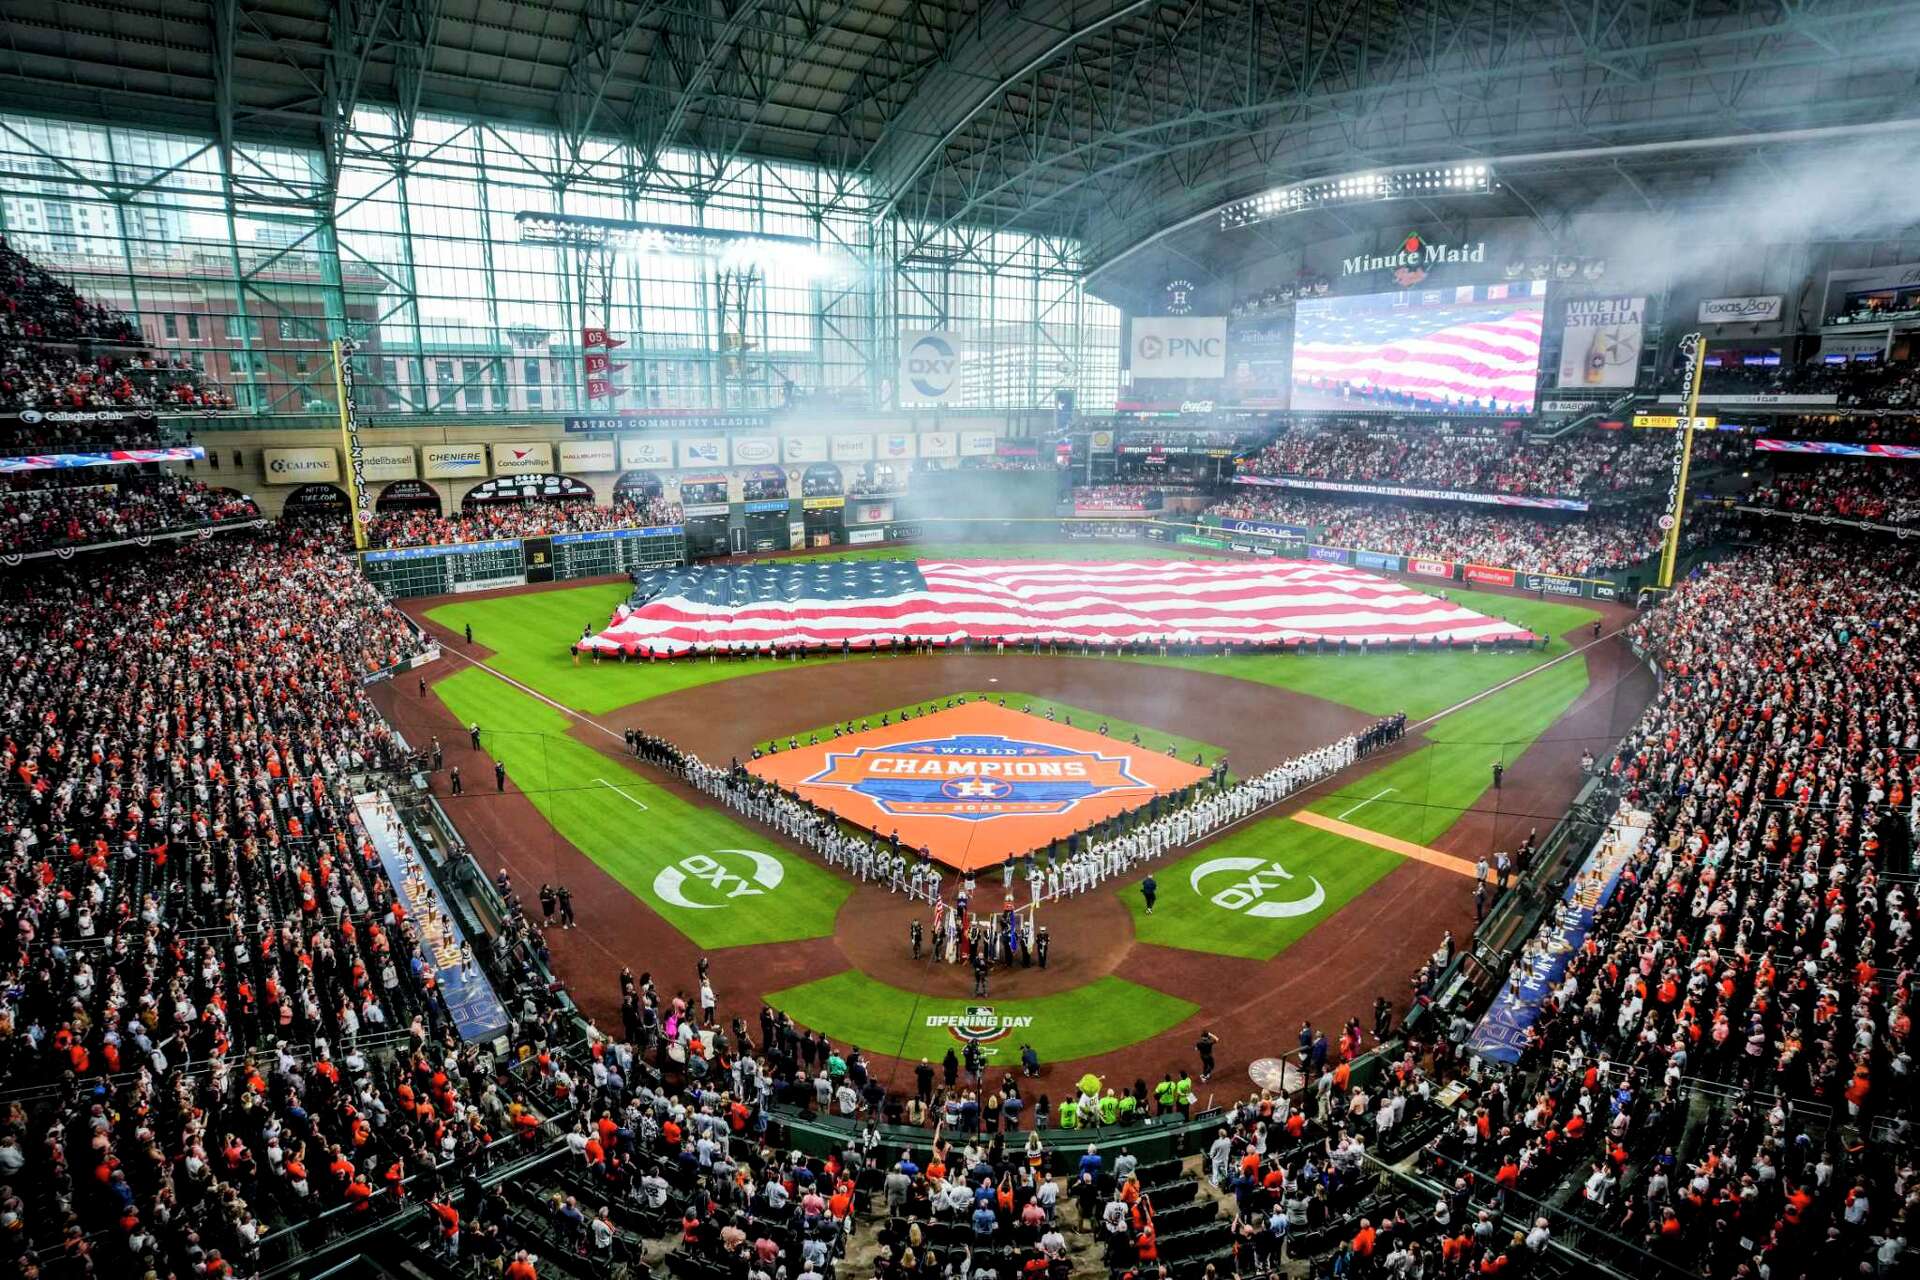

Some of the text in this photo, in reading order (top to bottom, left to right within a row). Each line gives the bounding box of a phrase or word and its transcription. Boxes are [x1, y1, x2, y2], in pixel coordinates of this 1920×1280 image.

[1342, 243, 1485, 276] Minute Maid
[1569, 297, 1631, 313] VIVE TU
[1703, 297, 1778, 315] Texas Bay
[1566, 311, 1640, 327] ESTRELLA
[588, 332, 603, 343] 05
[1168, 338, 1221, 358] PNC
[591, 359, 605, 369] 19
[908, 359, 955, 375] OXY
[1681, 360, 1695, 401] ROOT
[592, 383, 605, 394] 21
[45, 411, 124, 422] Gallagher Club
[572, 420, 624, 429] ASTROS
[630, 418, 709, 428] COMMUNITY
[342, 363, 370, 508] CHIKIN IZ FAIR
[363, 455, 412, 466] ndellbasell
[429, 452, 481, 462] CHENIERE
[497, 458, 550, 468] ConocoPhillips
[286, 460, 330, 470] CALPINE
[1664, 454, 1683, 513] CHIKIN
[1249, 525, 1292, 537] LEXUS
[1316, 549, 1341, 559] xfinity
[1543, 577, 1571, 586] ENERGY
[1543, 583, 1578, 595] TRANSFER
[941, 747, 1017, 755] WORLD
[868, 758, 1088, 776] CHAMPIONS
[957, 782, 997, 796] H
[679, 854, 766, 898] OXY
[1210, 862, 1295, 910] OXY
[926, 1015, 1033, 1027] OPENING DAY
